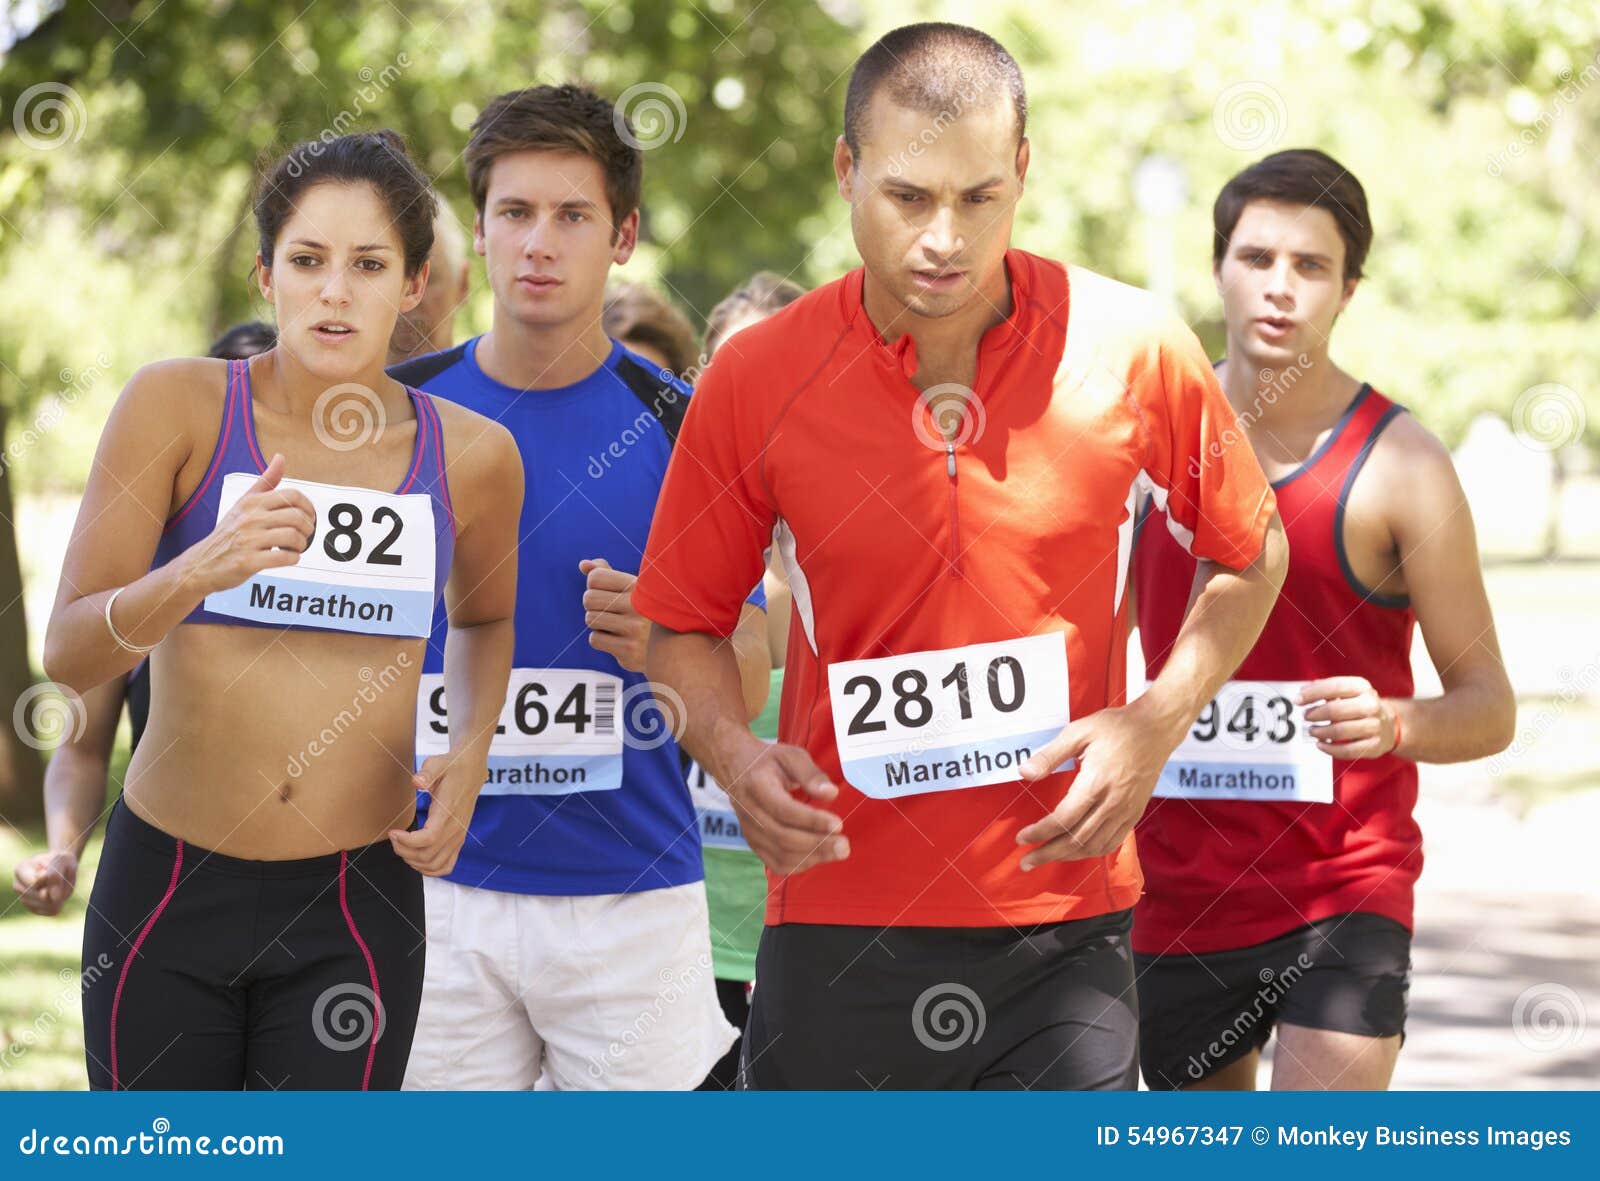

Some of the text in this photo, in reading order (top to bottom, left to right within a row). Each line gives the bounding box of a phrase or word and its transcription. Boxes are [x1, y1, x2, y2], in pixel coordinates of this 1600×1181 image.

[297, 502, 404, 566] 82
[249, 583, 394, 622] Marathon
[429, 682, 592, 736] 964
[843, 655, 1026, 736] 2810
[1192, 696, 1296, 743] 943
[484, 762, 586, 785] arathon
[885, 747, 1031, 788] Marathon
[1178, 768, 1295, 790] Marathon
